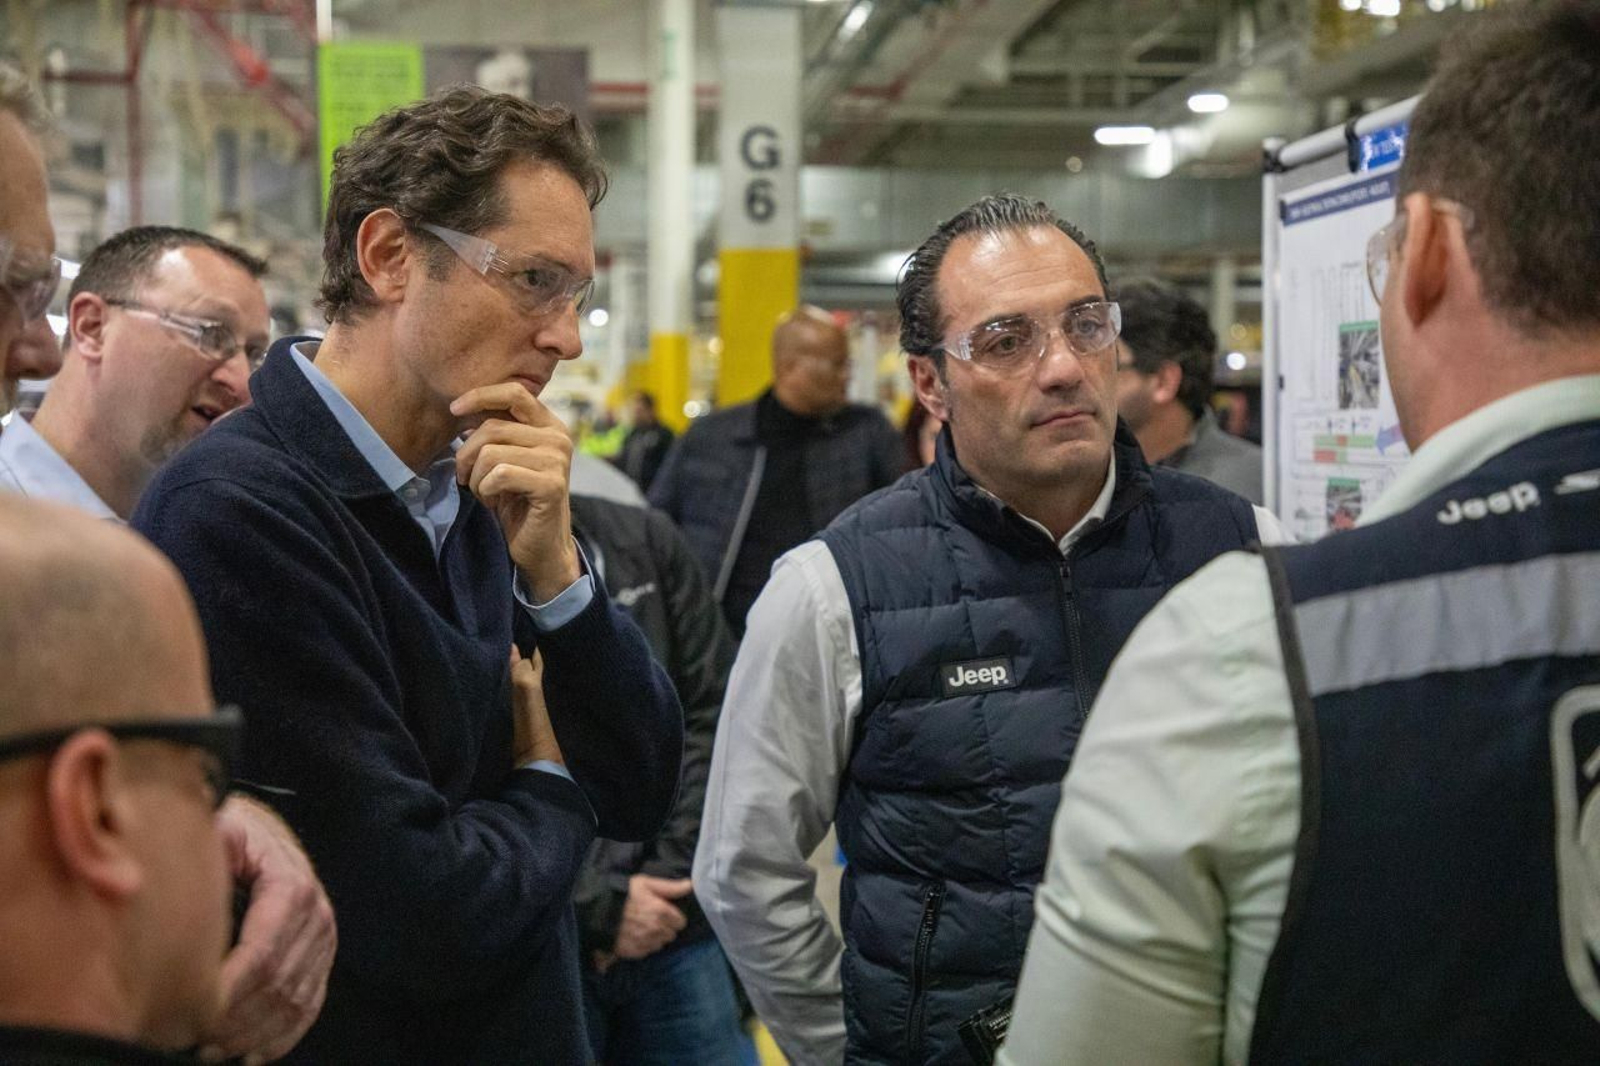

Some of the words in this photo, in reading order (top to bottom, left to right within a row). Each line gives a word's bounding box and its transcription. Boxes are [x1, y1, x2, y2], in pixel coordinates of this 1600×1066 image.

[741, 125, 780, 170] G
[745, 179, 776, 223] 6
[1436, 481, 1540, 525] Jeep
[948, 665, 1008, 687] Jeep
